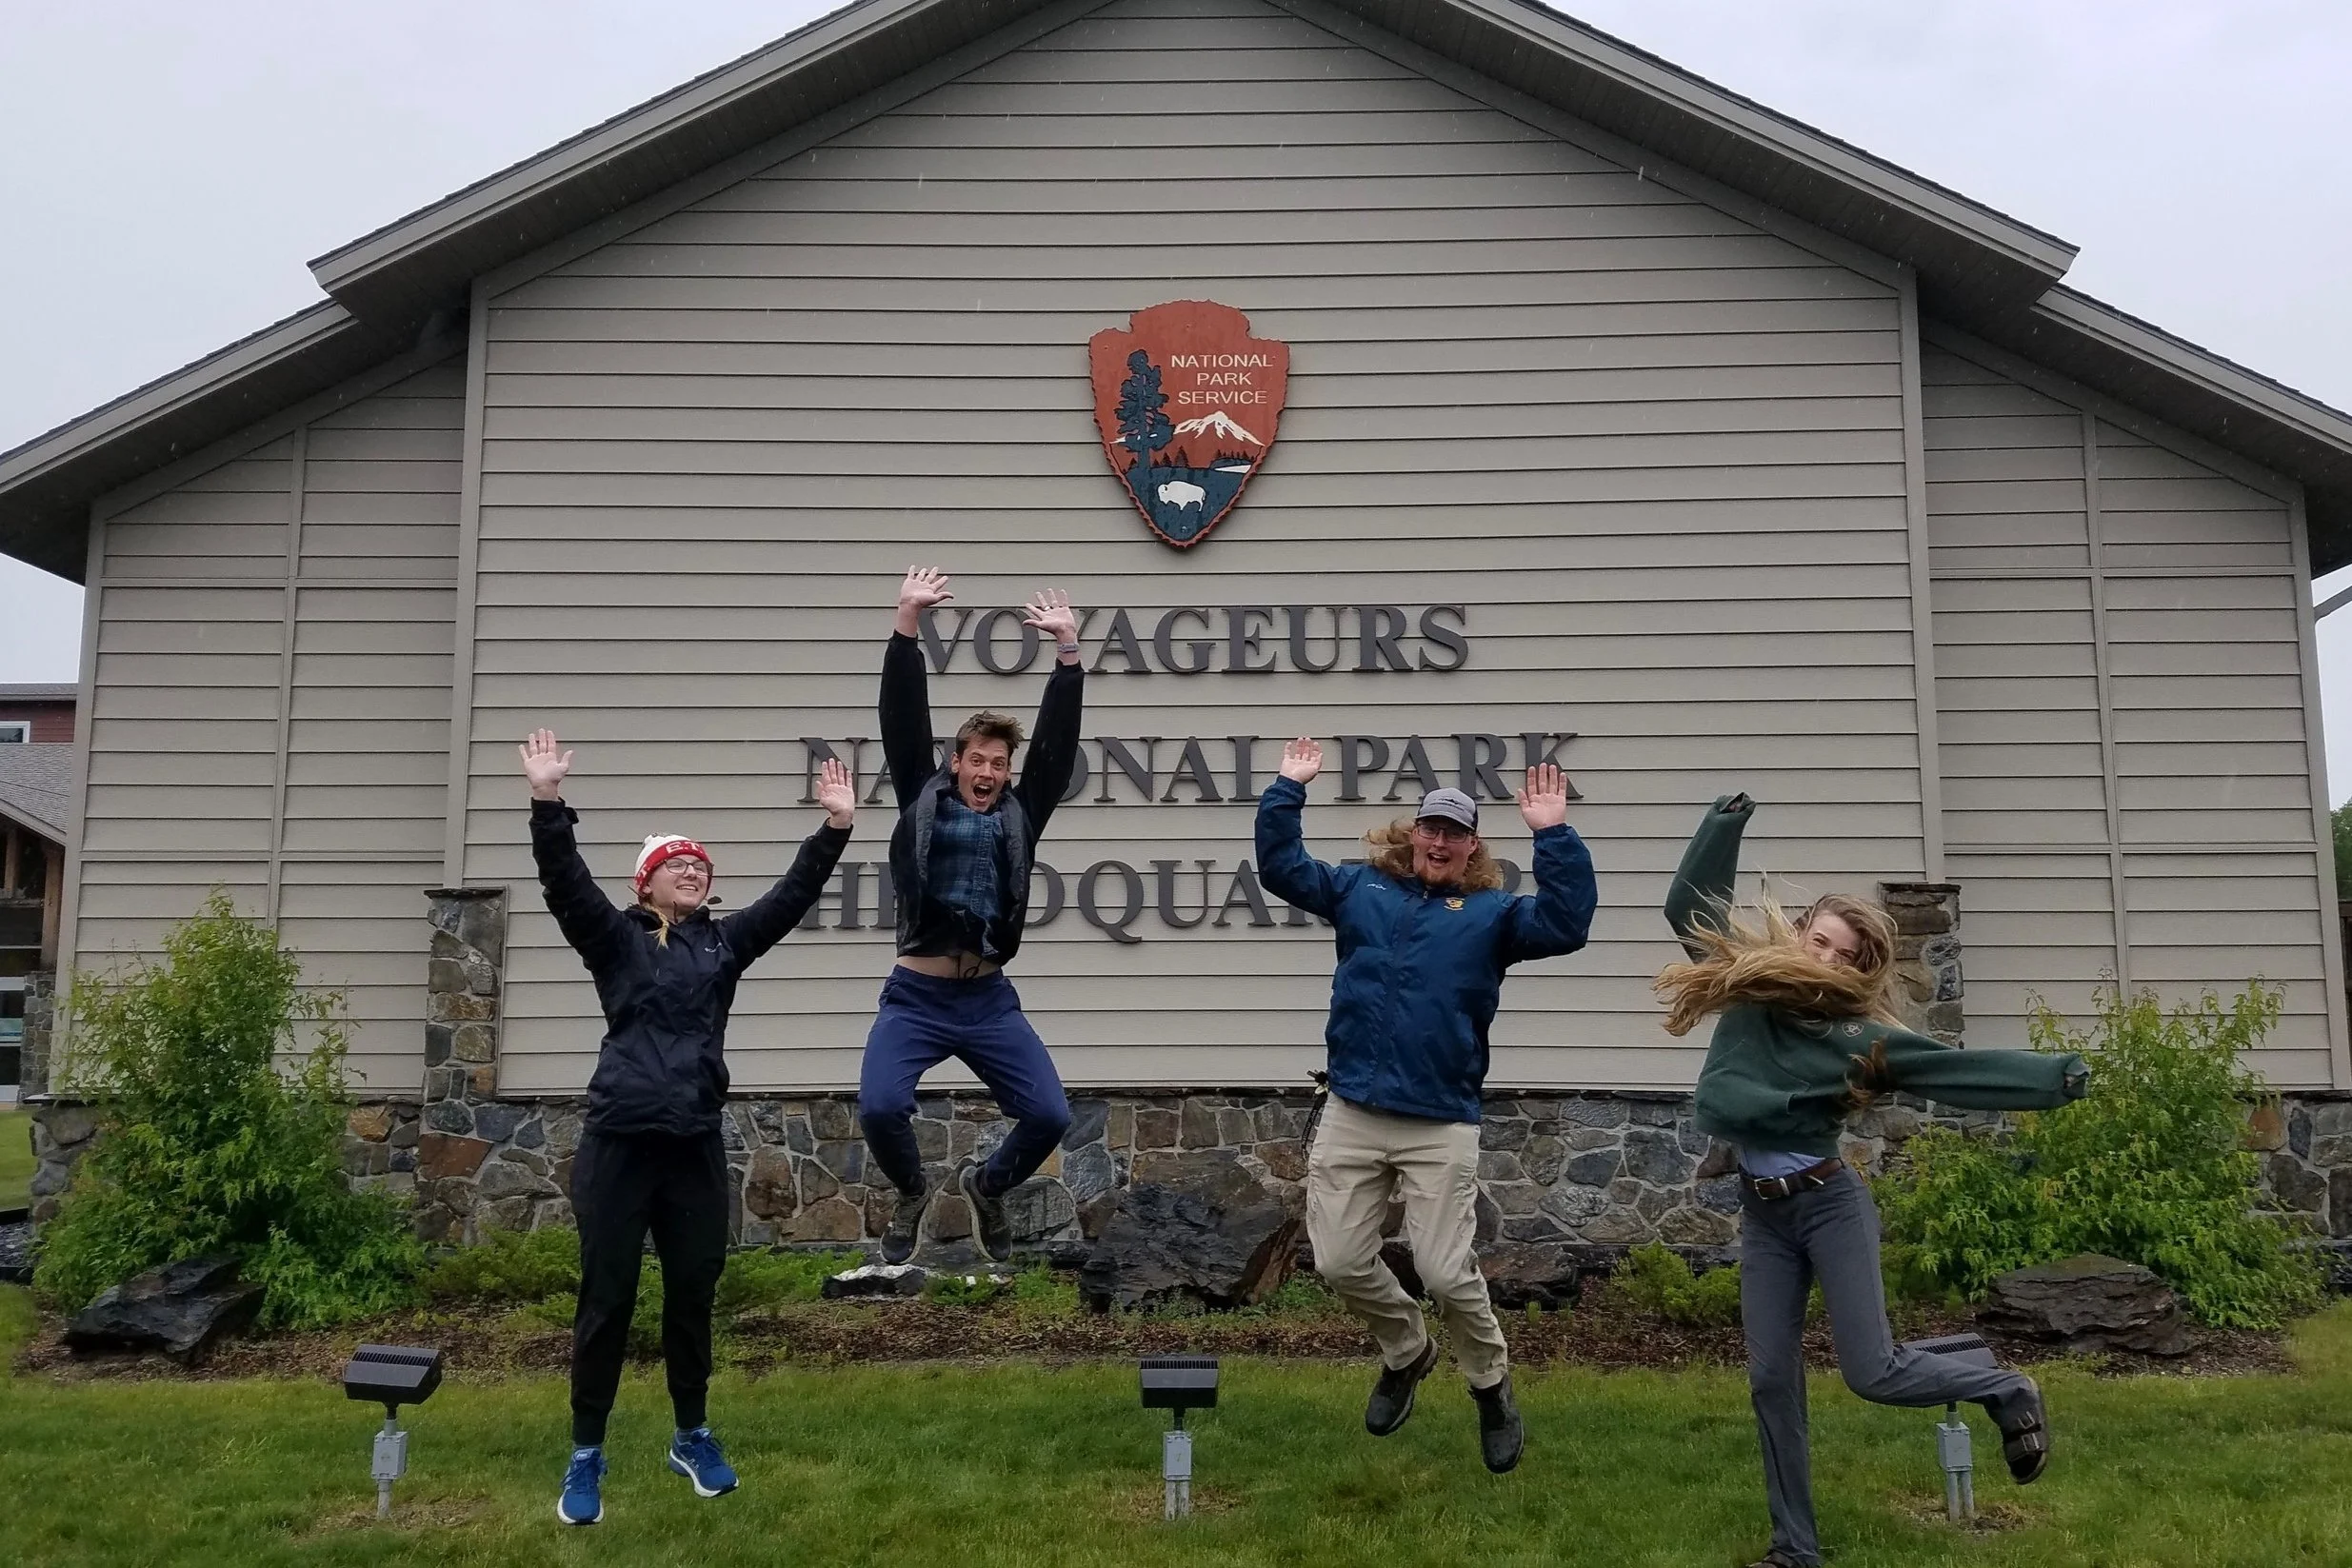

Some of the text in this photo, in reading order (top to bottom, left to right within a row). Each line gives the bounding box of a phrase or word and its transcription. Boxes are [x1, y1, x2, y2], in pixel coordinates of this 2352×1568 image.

[1170, 353, 1274, 368] NATIONAL
[1196, 372, 1252, 386] PARK
[1177, 390, 1268, 405] SERVICE
[1333, 732, 1584, 801] PARK
